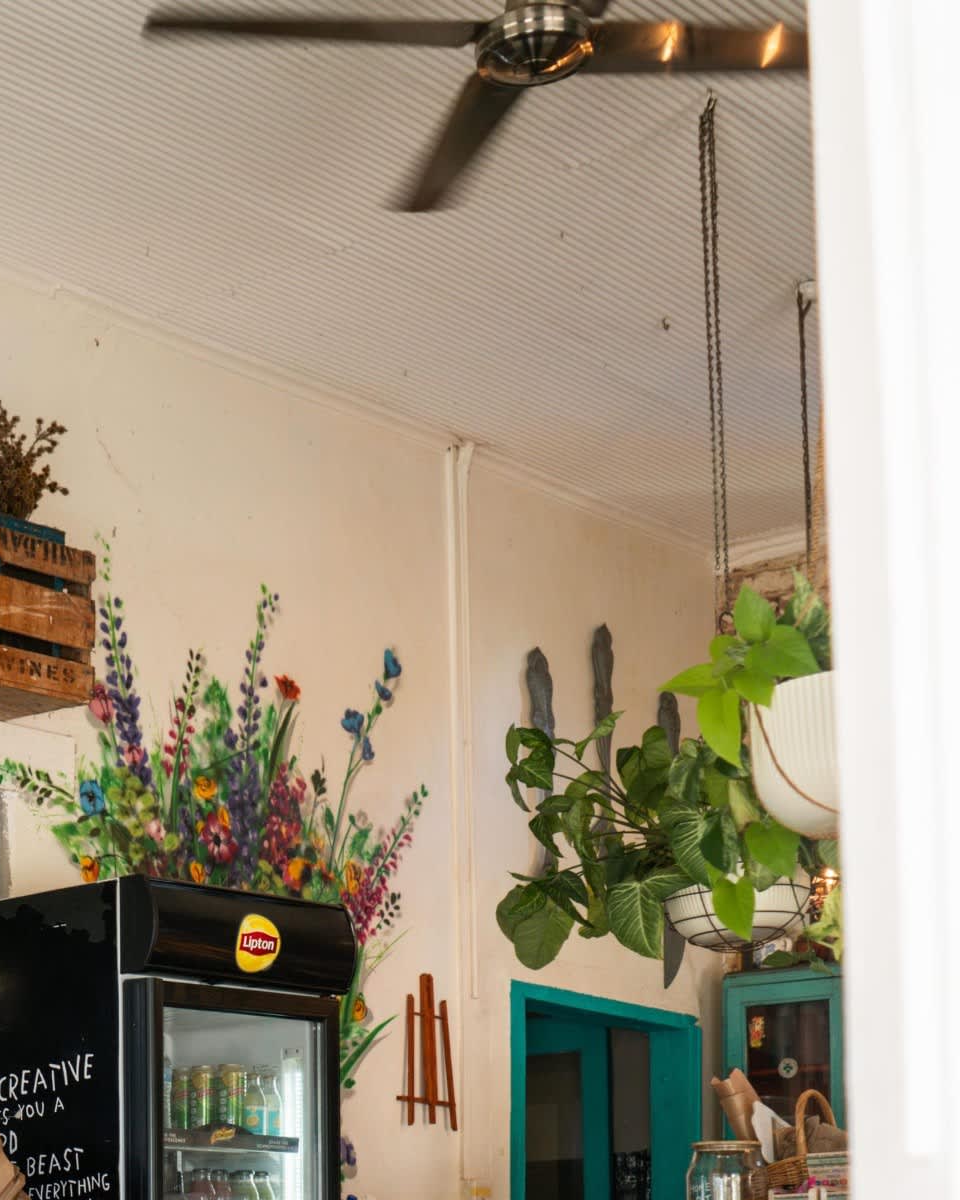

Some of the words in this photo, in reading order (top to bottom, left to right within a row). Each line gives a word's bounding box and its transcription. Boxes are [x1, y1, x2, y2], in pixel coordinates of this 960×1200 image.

[243, 935, 275, 951] Lipton
[17, 1101, 45, 1121] YOU
[54, 1096, 65, 1113] A
[26, 1147, 84, 1177] BEAST
[28, 1172, 111, 1200] EVERYTHING
